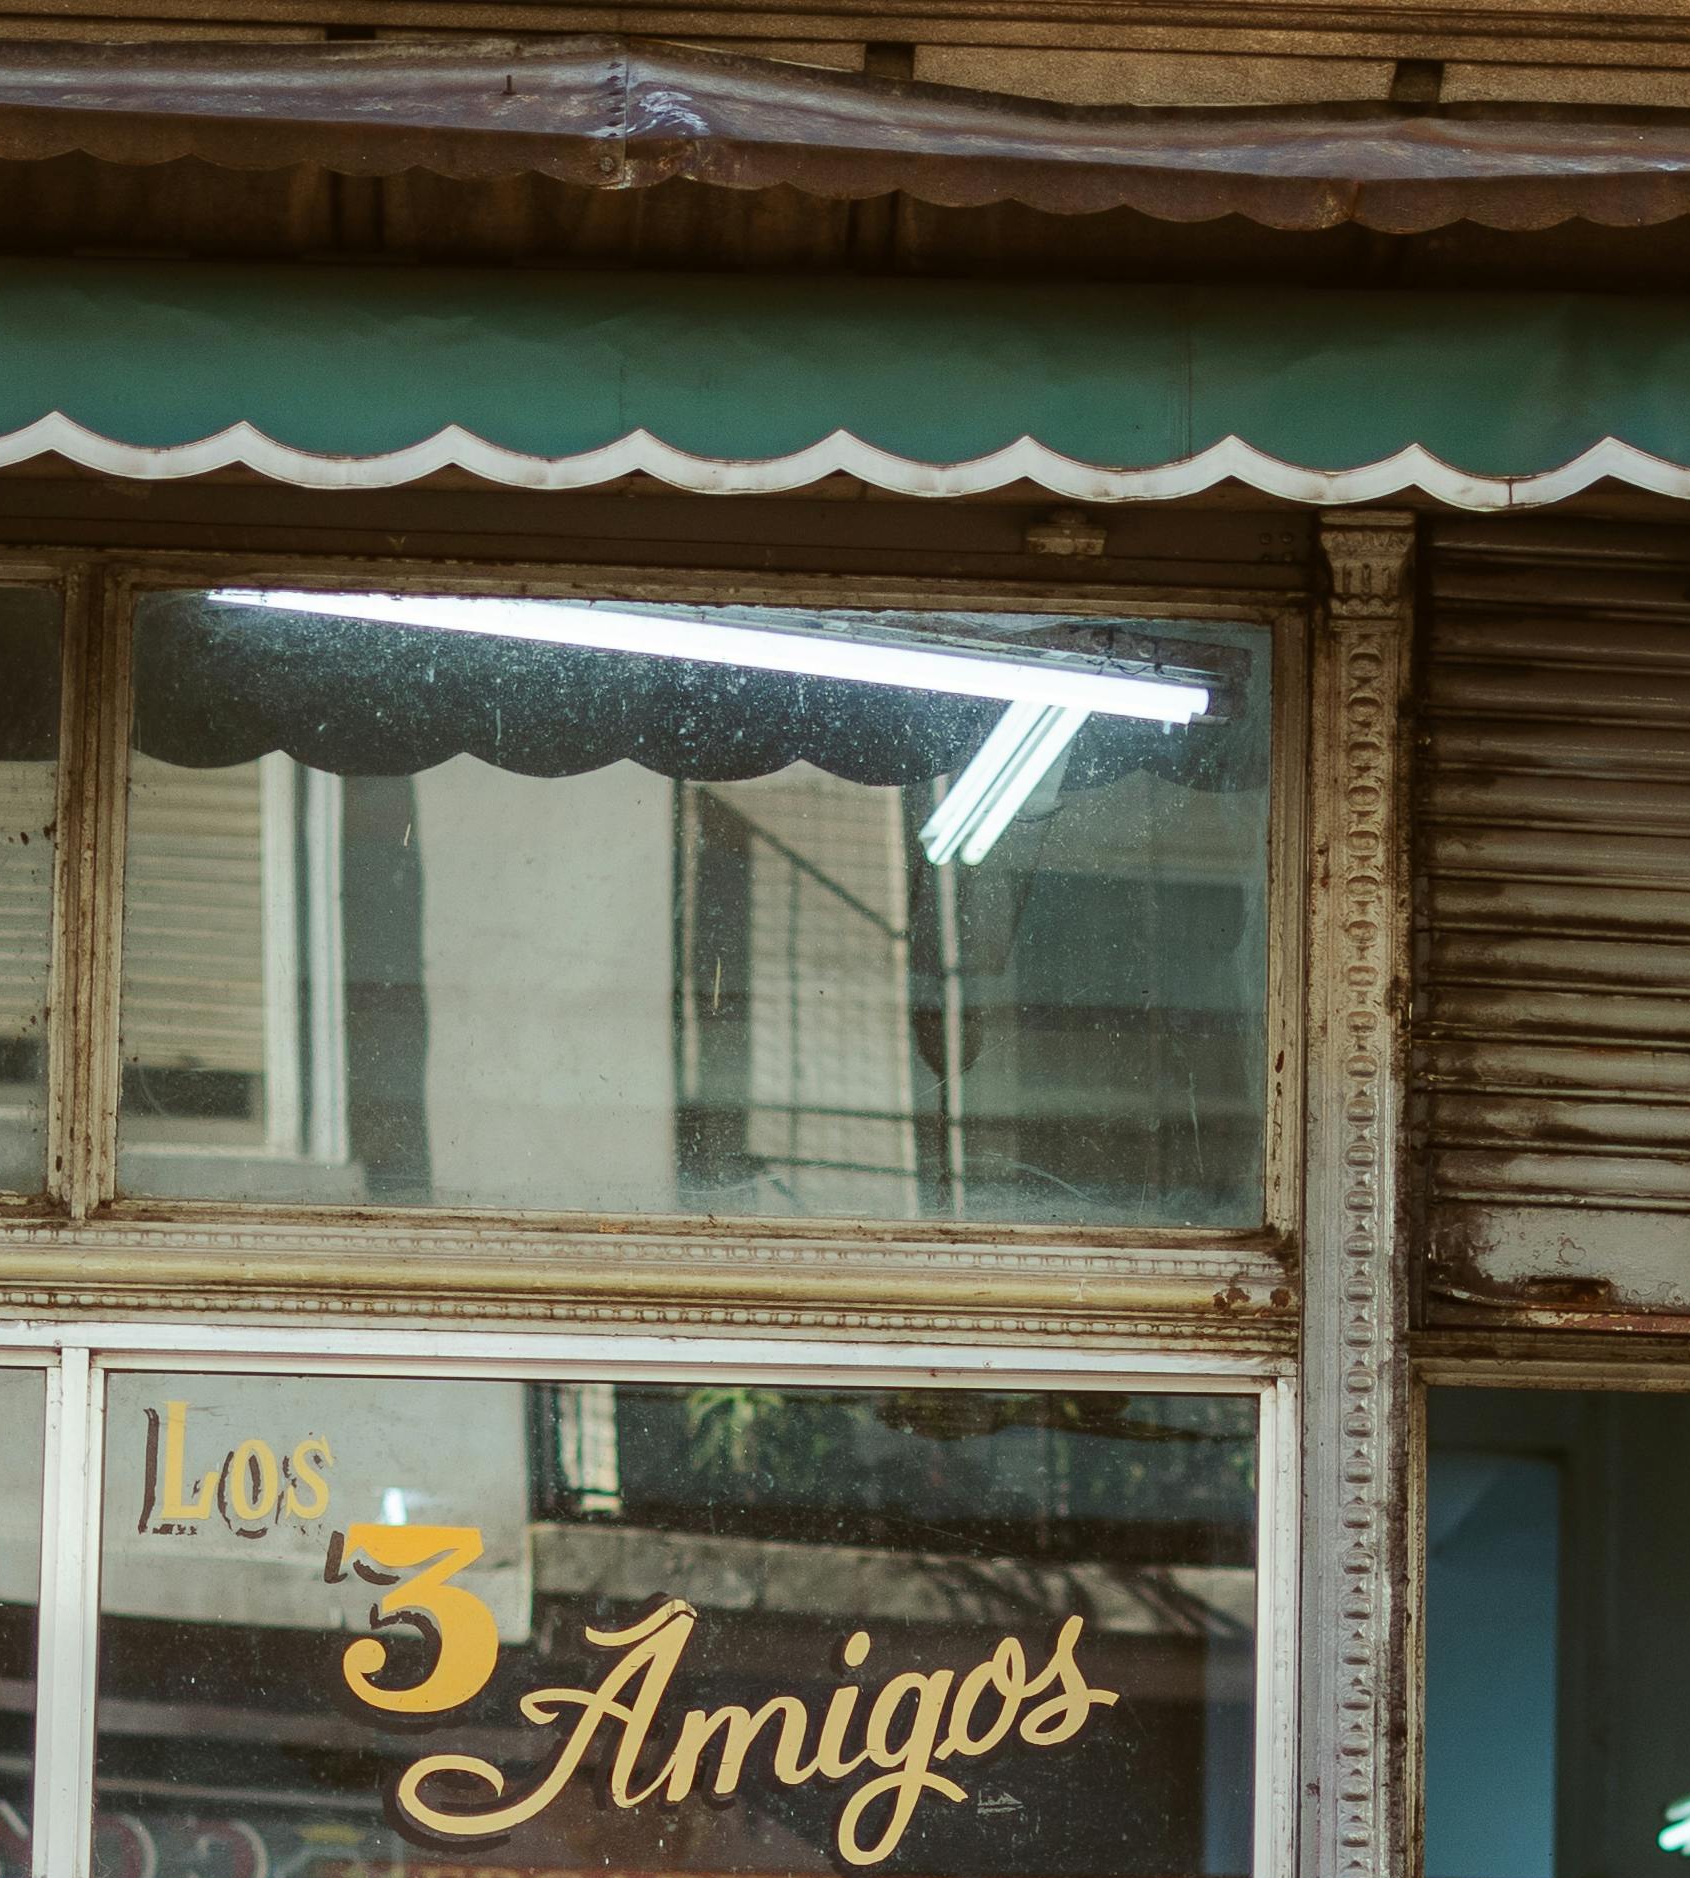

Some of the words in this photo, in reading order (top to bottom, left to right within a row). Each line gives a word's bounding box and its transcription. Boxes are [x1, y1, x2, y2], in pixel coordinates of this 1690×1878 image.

[147, 1400, 334, 1530] Los
[343, 1524, 499, 1714] 3
[398, 1598, 1118, 1866] Amigos
